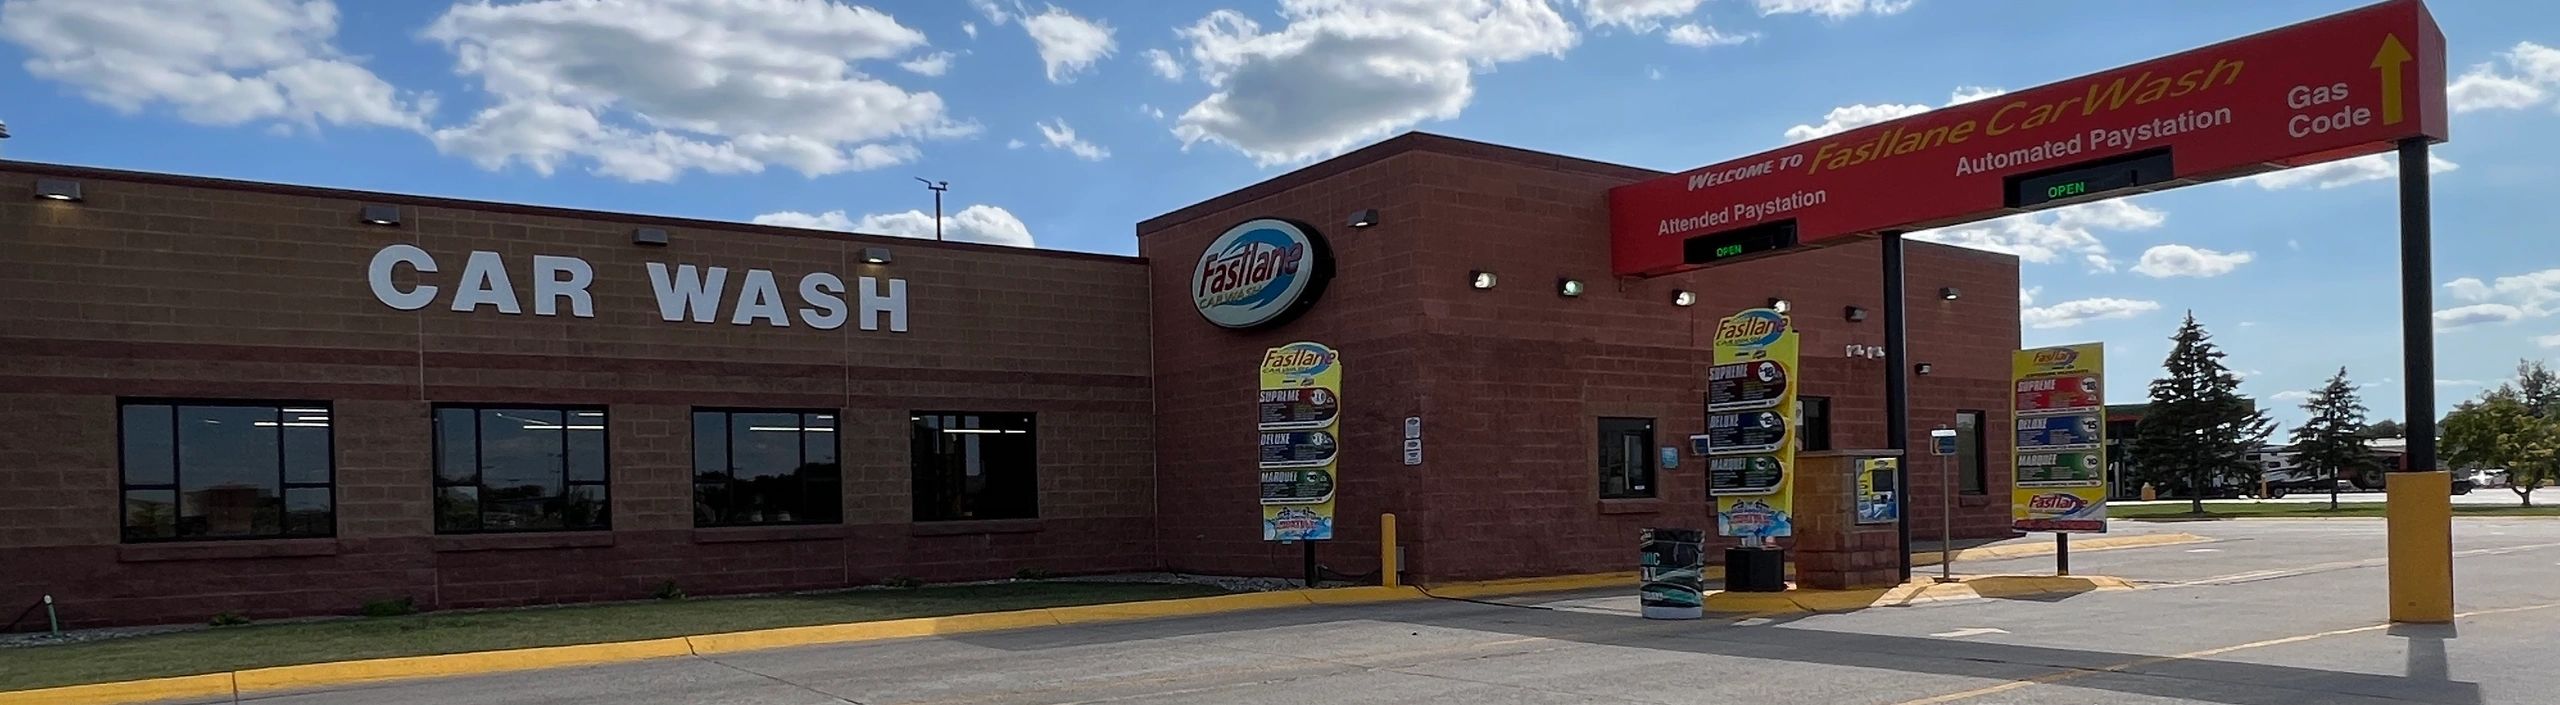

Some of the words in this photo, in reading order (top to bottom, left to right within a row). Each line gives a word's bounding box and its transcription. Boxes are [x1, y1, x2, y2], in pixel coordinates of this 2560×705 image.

[2287, 82, 2349, 109] Gas
[2288, 105, 2372, 138] Code
[1956, 137, 2082, 177] Automated
[2090, 107, 2232, 150] Paystation
[1688, 160, 1774, 191] WELCOME
[2047, 182, 2085, 198] OPEN
[1658, 207, 1729, 236] Attended
[1734, 190, 1827, 221] Paystation
[1716, 244, 1742, 258] OPEN
[1199, 242, 1304, 297] Fastlane
[368, 244, 595, 317] CAR
[645, 262, 908, 333] WASH
[1715, 317, 1788, 340] Fastlane
[1263, 350, 1336, 368] Fastlane
